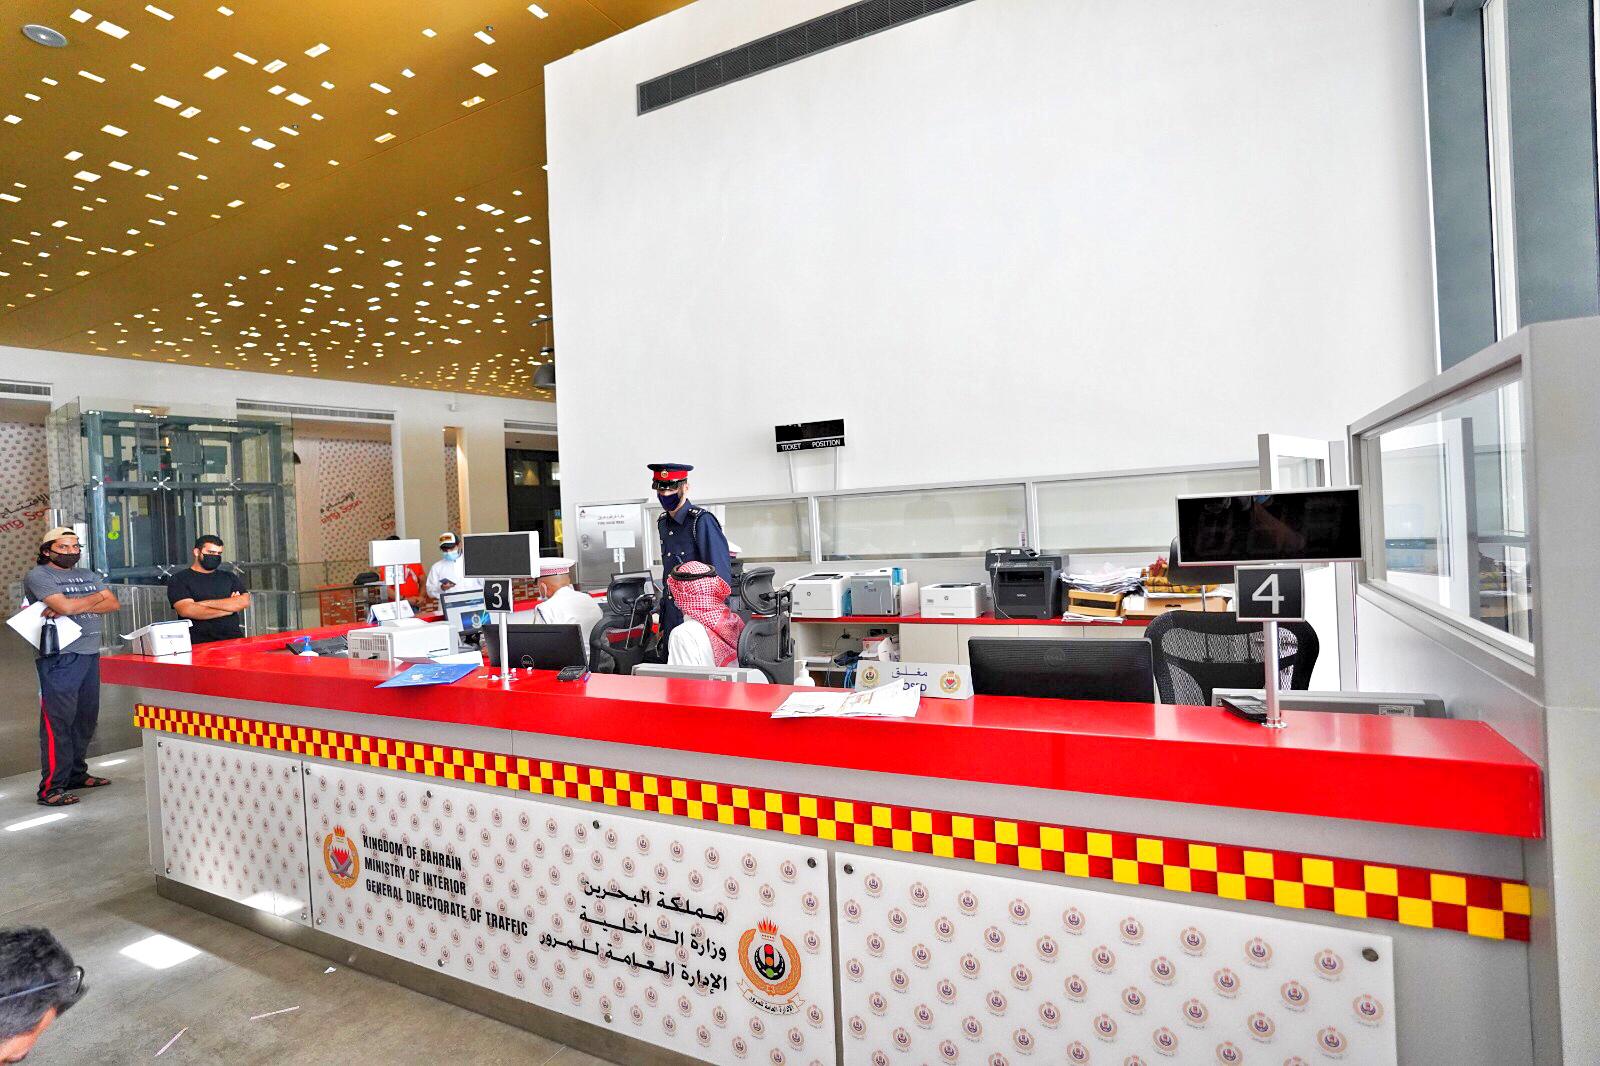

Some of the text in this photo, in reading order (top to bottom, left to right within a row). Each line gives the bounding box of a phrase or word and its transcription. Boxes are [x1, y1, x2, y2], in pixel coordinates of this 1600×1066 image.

[781, 439, 841, 451] TICKET POSITION
[491, 583, 503, 609] 3
[1251, 573, 1285, 614] 4
[891, 665, 928, 679] مغلق
[363, 835, 462, 871] KINGDOM OF BAHRAIN
[364, 857, 466, 896] MINISTRY OF INTERIOR
[366, 879, 528, 937] GENERAL DIRECTORATE OF TRAFFIC
[584, 880, 725, 923] مملكة البحرين
[579, 905, 727, 961] وزارة الداخلية
[539, 933, 727, 994] الإدارة العامة للمرور
